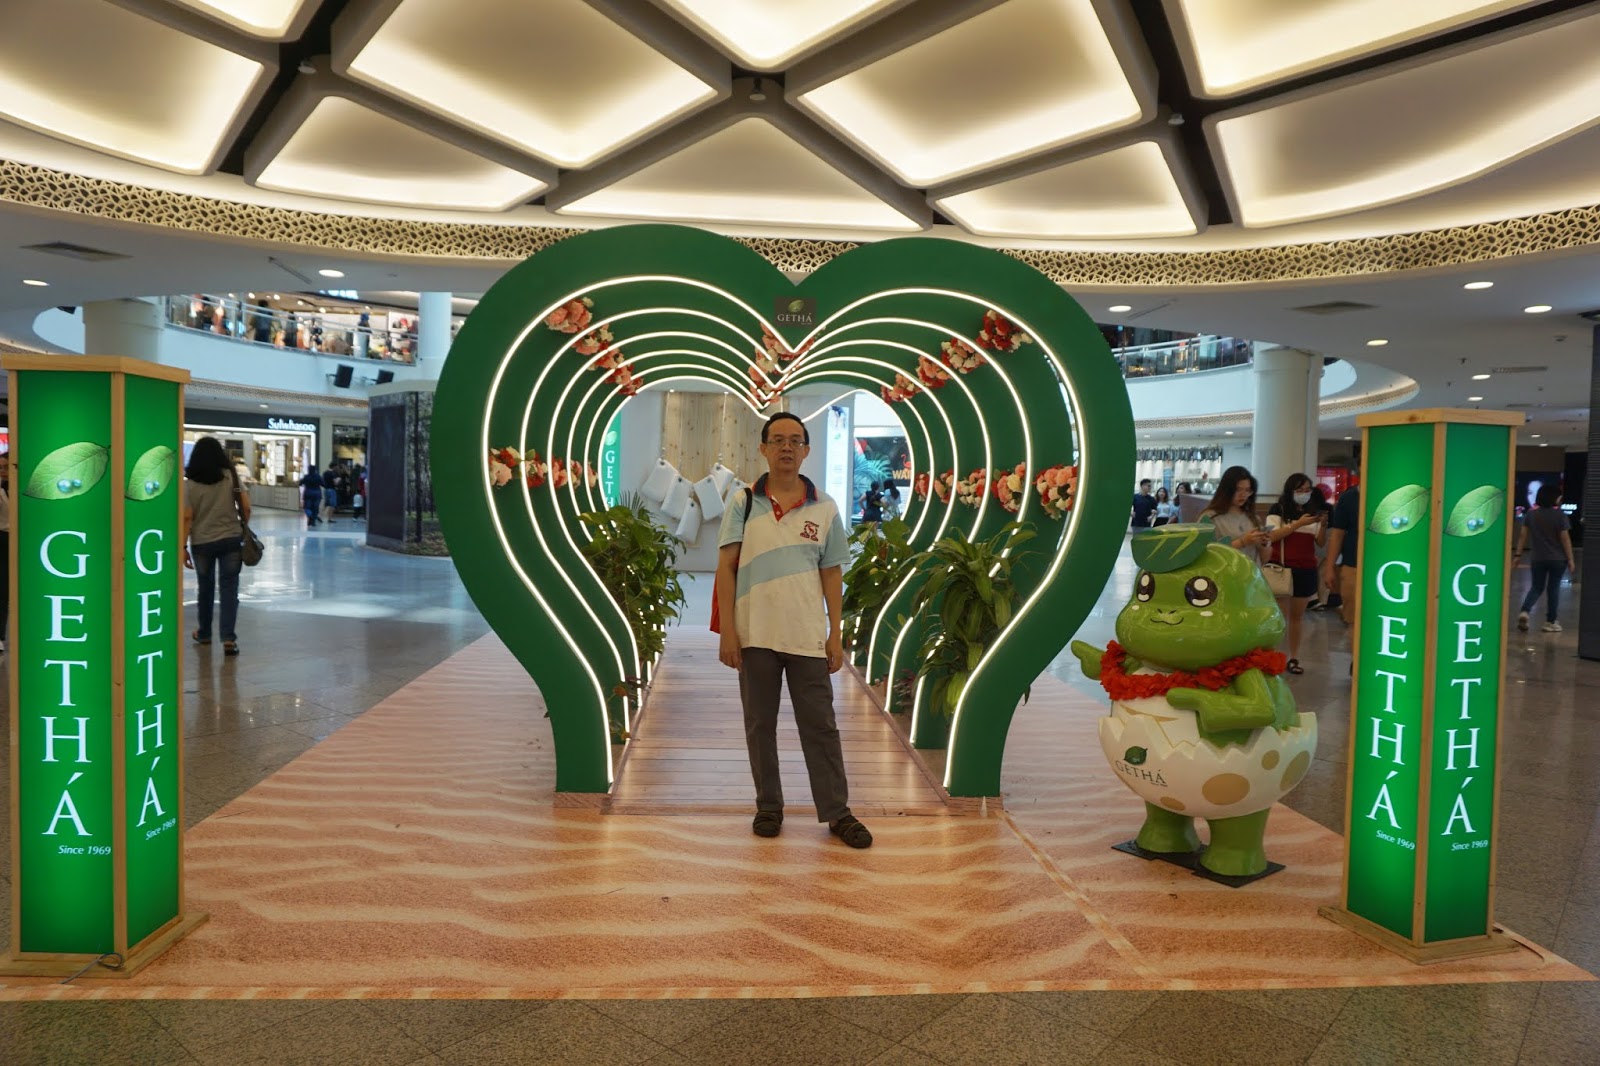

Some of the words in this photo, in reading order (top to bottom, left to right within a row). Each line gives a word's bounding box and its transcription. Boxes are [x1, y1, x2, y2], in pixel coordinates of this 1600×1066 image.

[777, 313, 812, 322] GETHÁ
[268, 417, 316, 431] Sulwhasoo
[605, 450, 615, 508] GETH
[40, 530, 92, 836] GETHÁ
[135, 529, 165, 827] GETHÁ
[1366, 560, 1413, 829] GETHÁ
[1441, 563, 1488, 836] GETHÁ
[1116, 760, 1167, 784] GETHÁ
[145, 827, 161, 841] Since
[162, 817, 176, 831] 1969
[1376, 829, 1395, 843] Since
[1396, 837, 1416, 850] 1969
[58, 845, 84, 855] Since
[88, 845, 111, 856] 1969
[1451, 842, 1470, 851] Since
[1471, 839, 1489, 849] 1969
